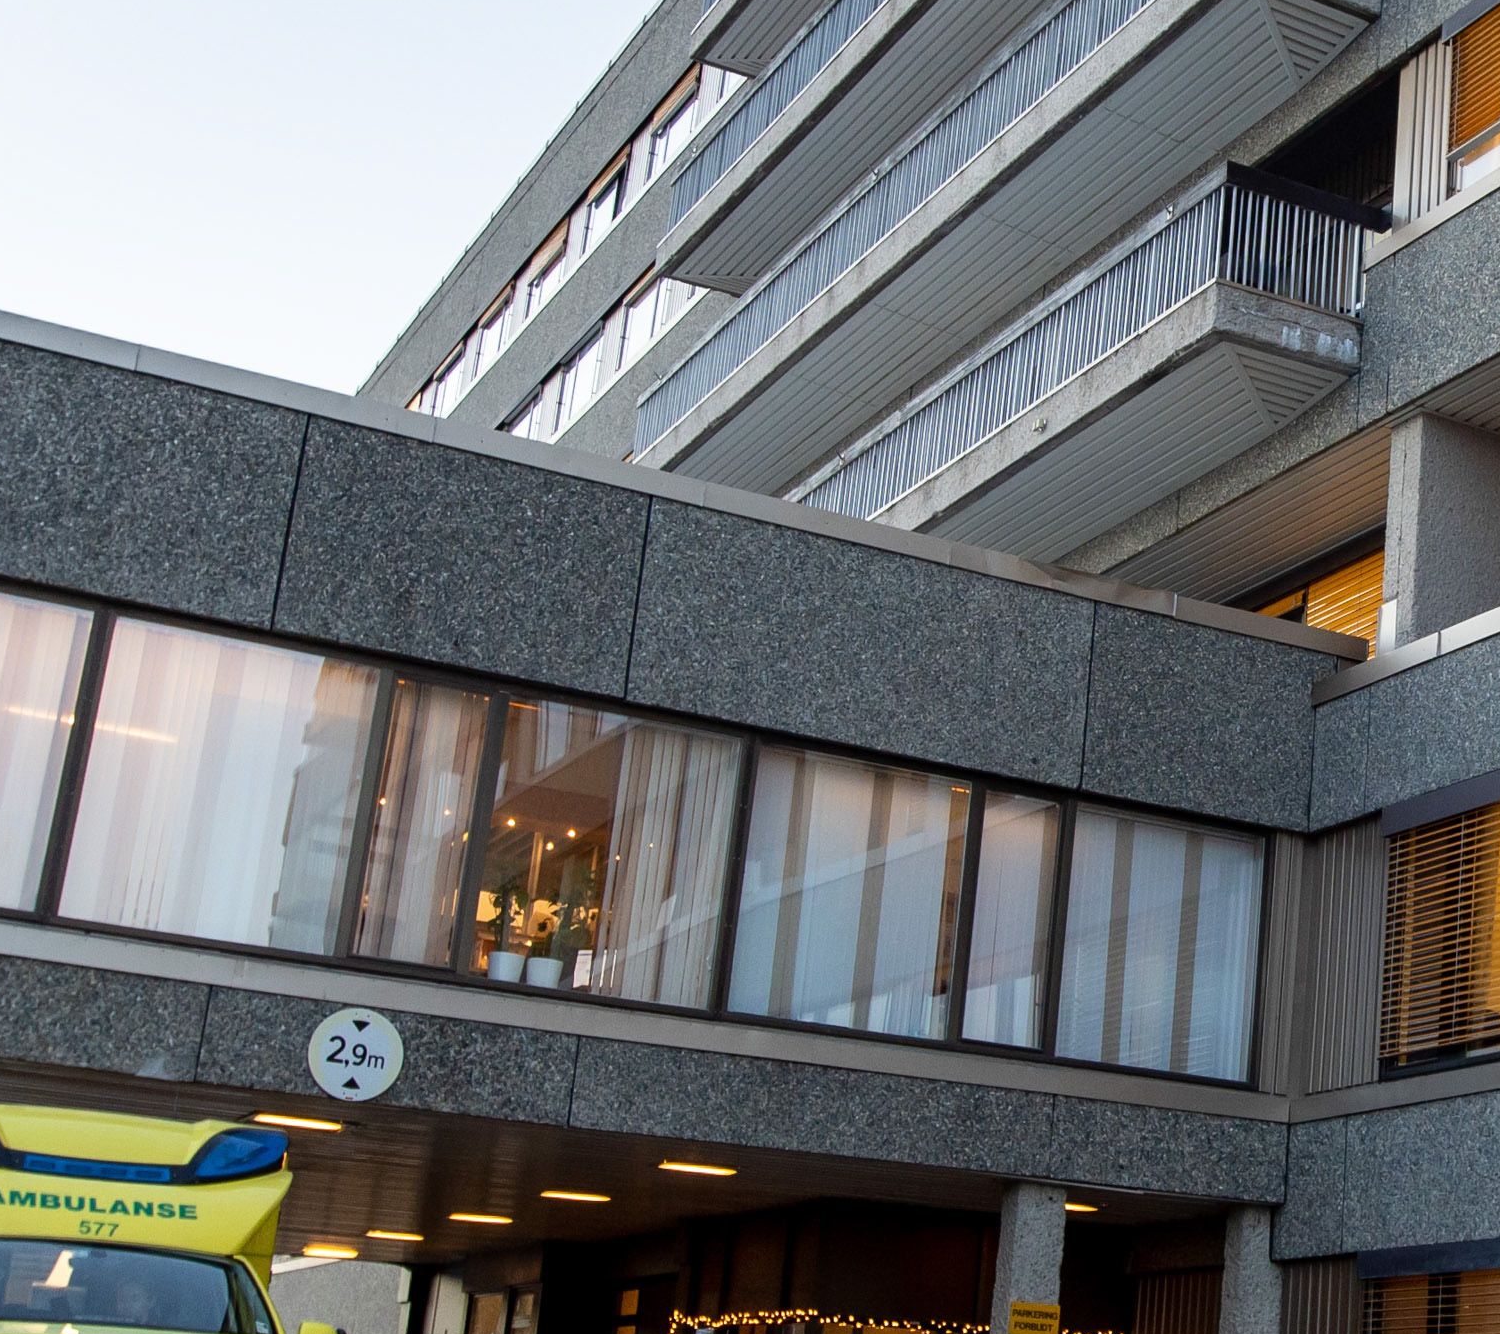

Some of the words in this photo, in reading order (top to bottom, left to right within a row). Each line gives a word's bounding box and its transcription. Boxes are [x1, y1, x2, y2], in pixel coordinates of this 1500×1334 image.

[78, 1219, 120, 1238] 577
[1012, 1308, 1059, 1320] PARKERING
[1014, 1321, 1054, 1332] FORBUDT
